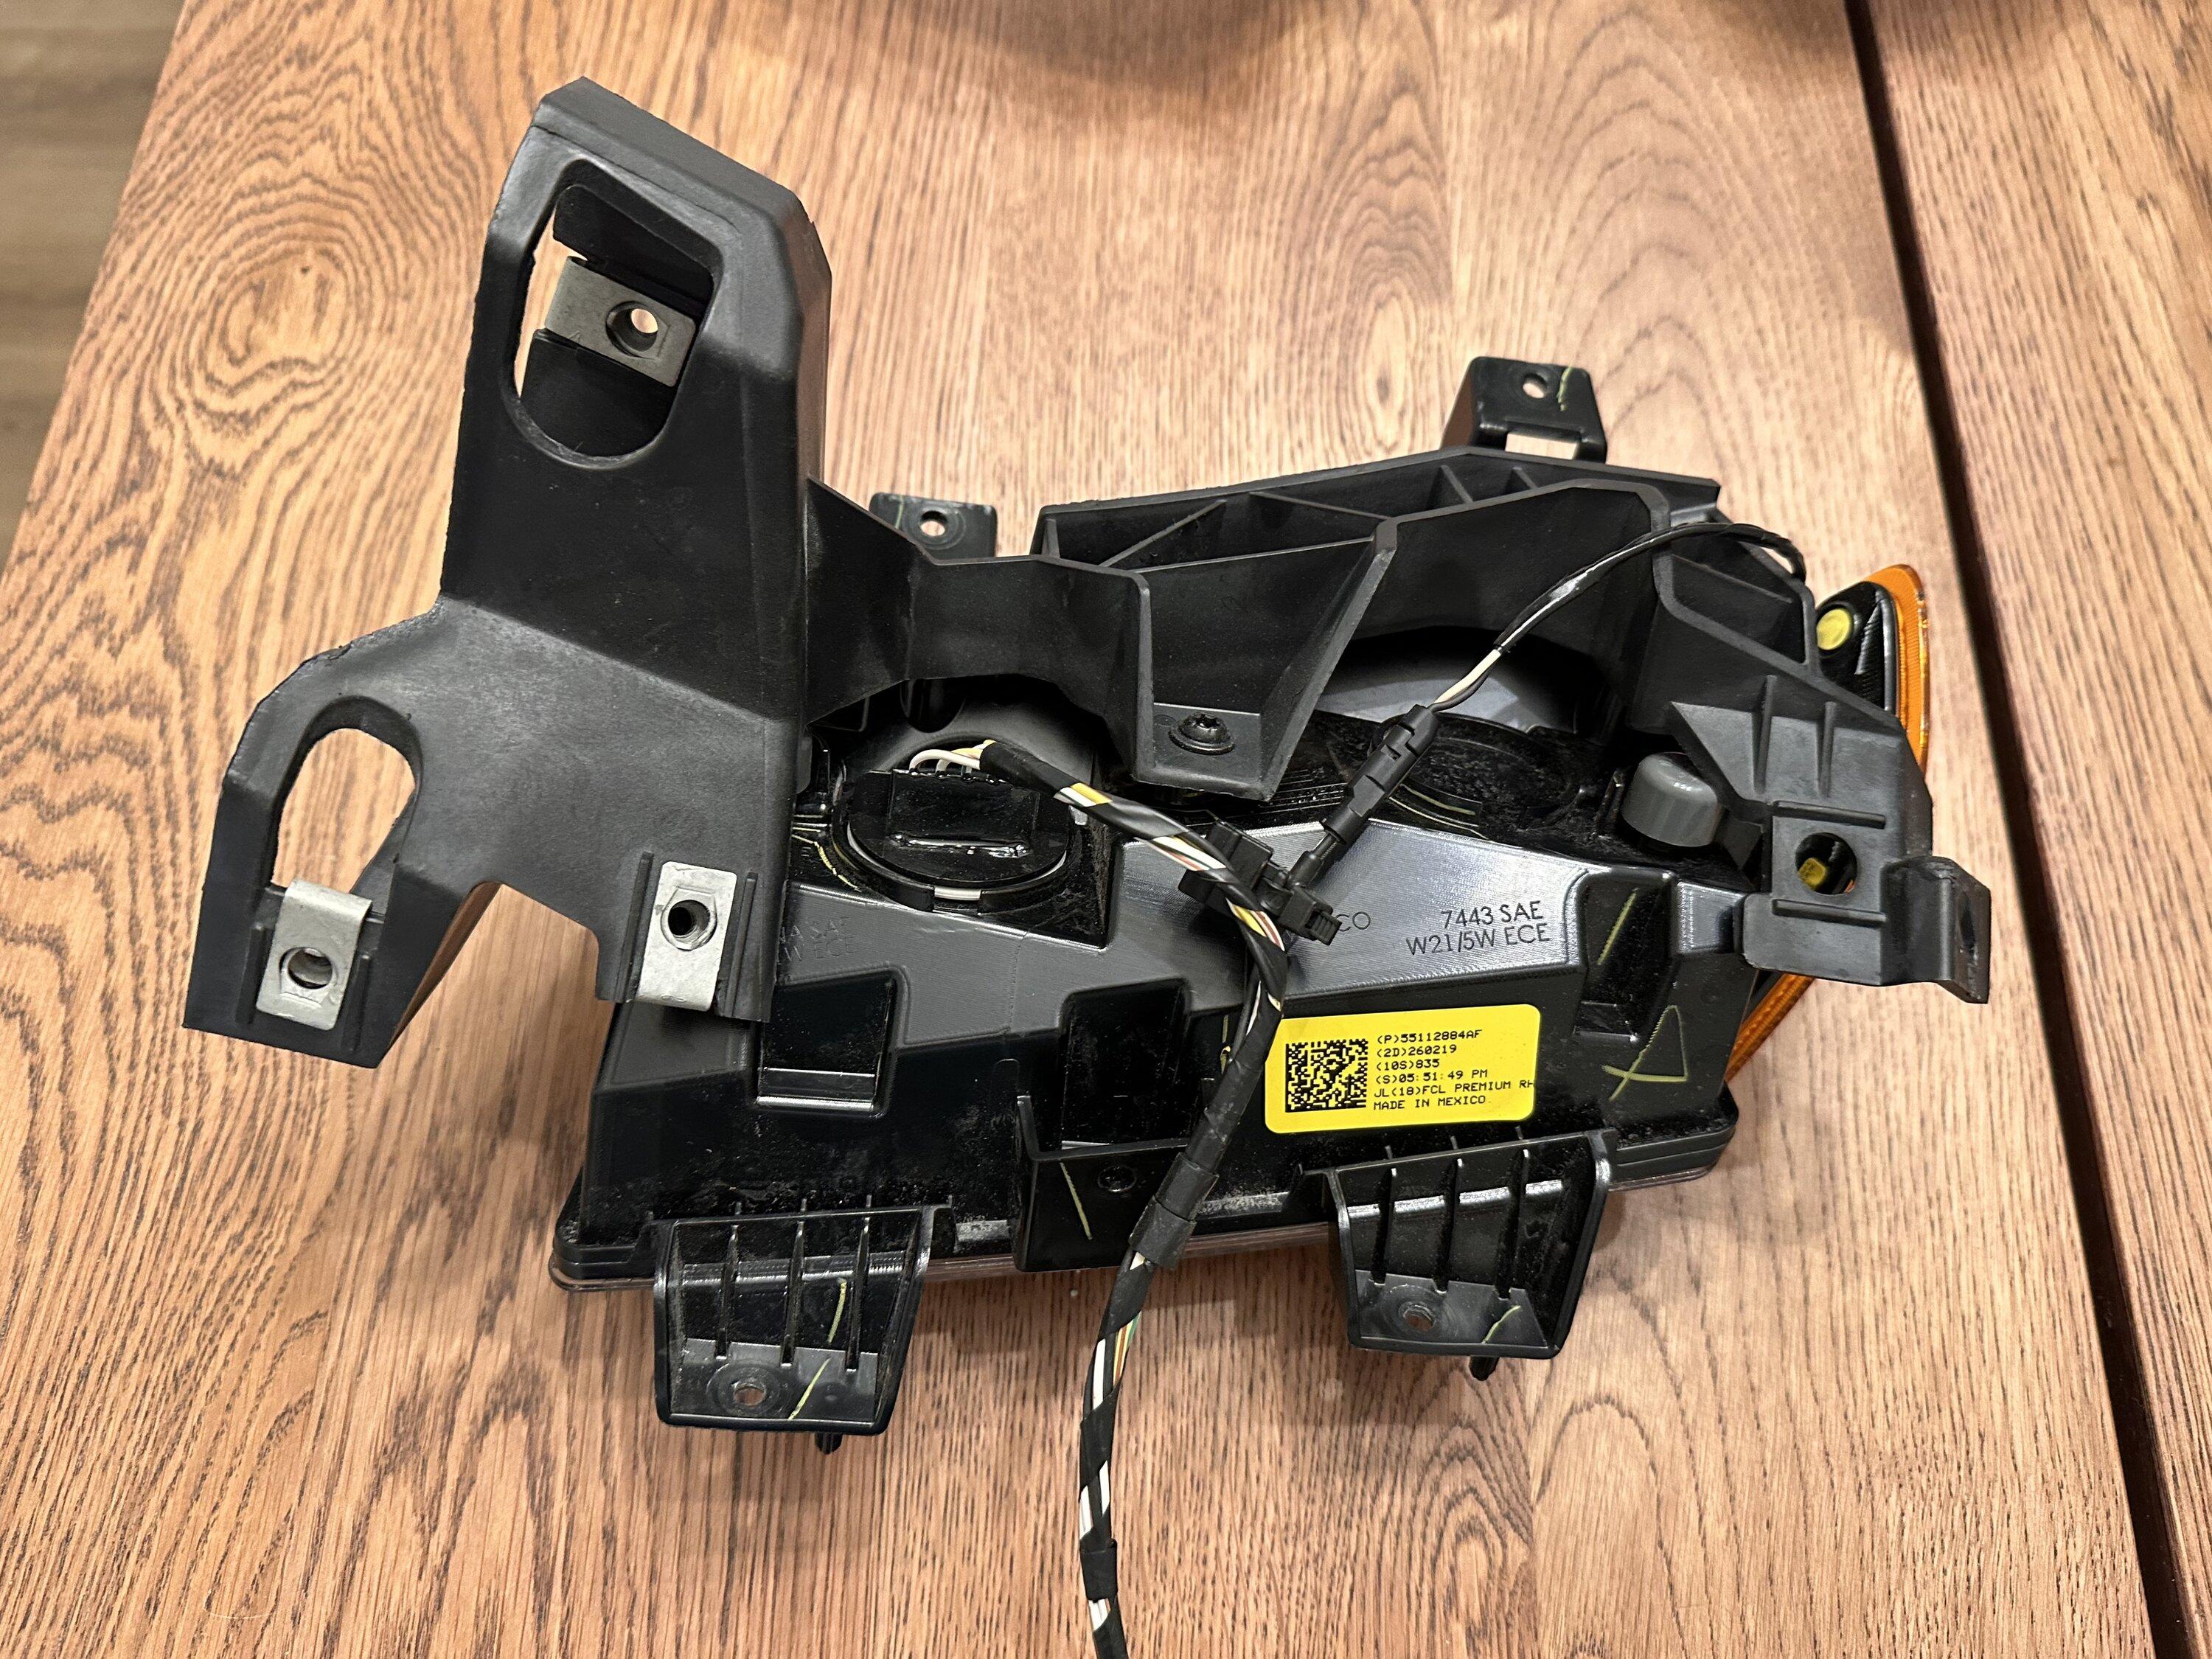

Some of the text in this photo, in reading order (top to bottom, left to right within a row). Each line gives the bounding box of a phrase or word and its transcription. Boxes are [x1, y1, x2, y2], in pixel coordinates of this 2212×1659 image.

[1441, 900, 1543, 929] 7443 SAE
[1405, 922, 1551, 956] W21/5W ECE
[1377, 1029, 1483, 1044] (P)55112884AF
[1377, 1044, 1457, 1058] (2D)260219
[1377, 1058, 1440, 1071] (10S)835
[1472, 1069, 1488, 1079] PM
[1374, 1085, 1446, 1098] JL(18)FCL
[1454, 1082, 1512, 1093] PREMIUM
[1373, 1100, 1405, 1110] MADE
[1414, 1099, 1430, 1109] IN
